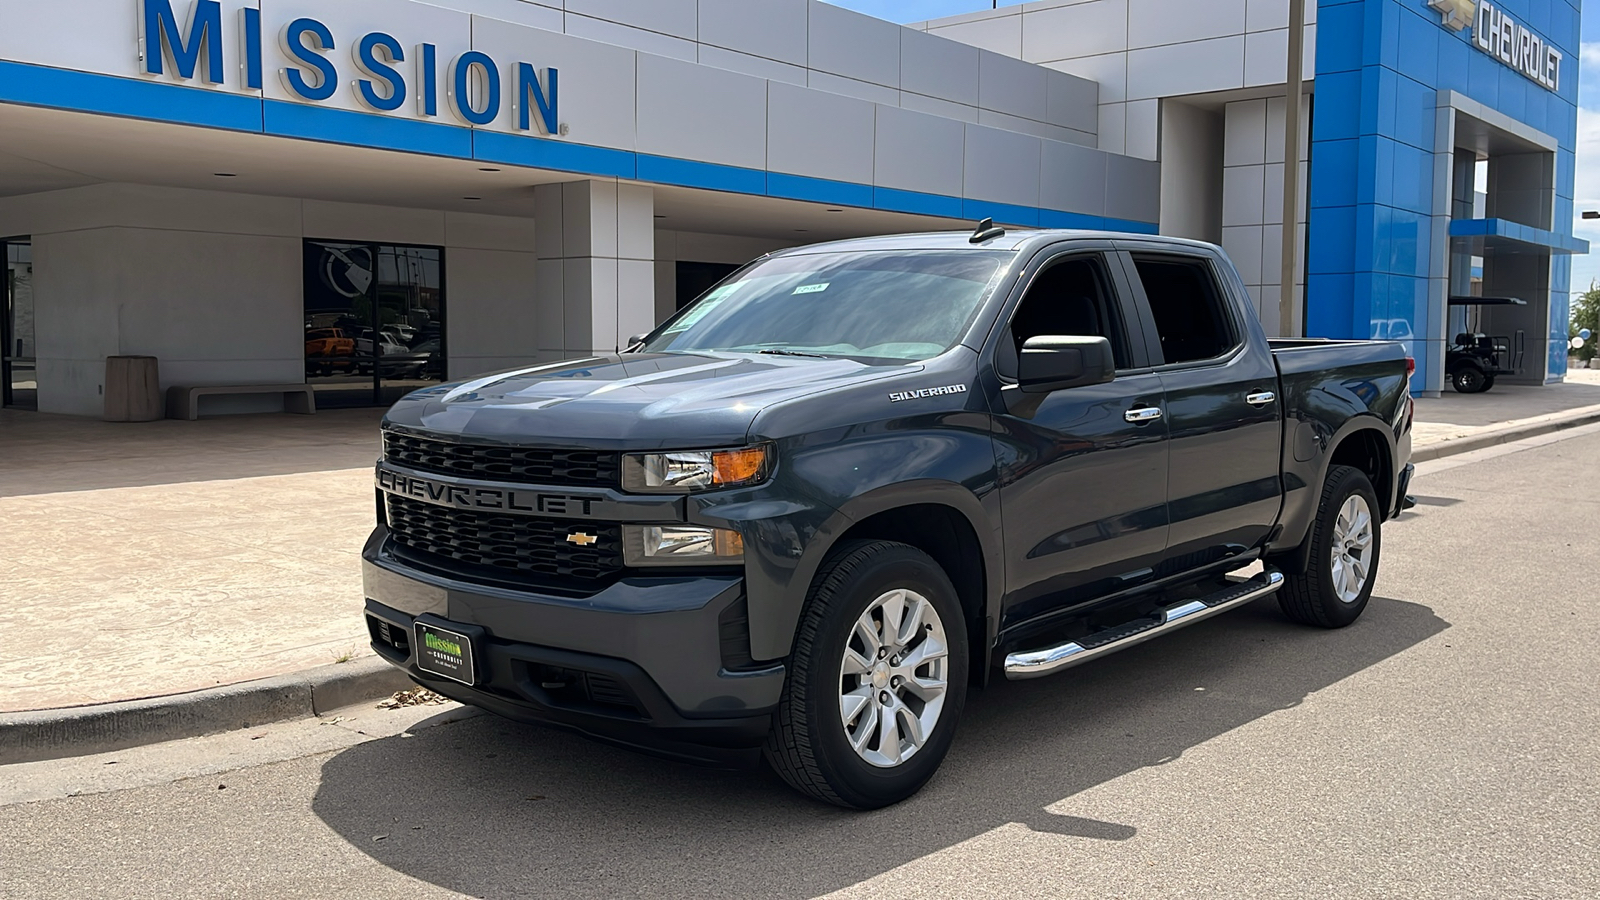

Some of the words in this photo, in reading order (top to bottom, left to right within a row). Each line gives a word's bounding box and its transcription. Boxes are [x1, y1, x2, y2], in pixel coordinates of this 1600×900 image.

[139, 0, 559, 135] MISSION
[1476, 0, 1563, 92] CHEVROLET
[889, 383, 967, 402] SILVERADO
[379, 468, 603, 516] CHEVROLET
[425, 632, 462, 657] Mission
